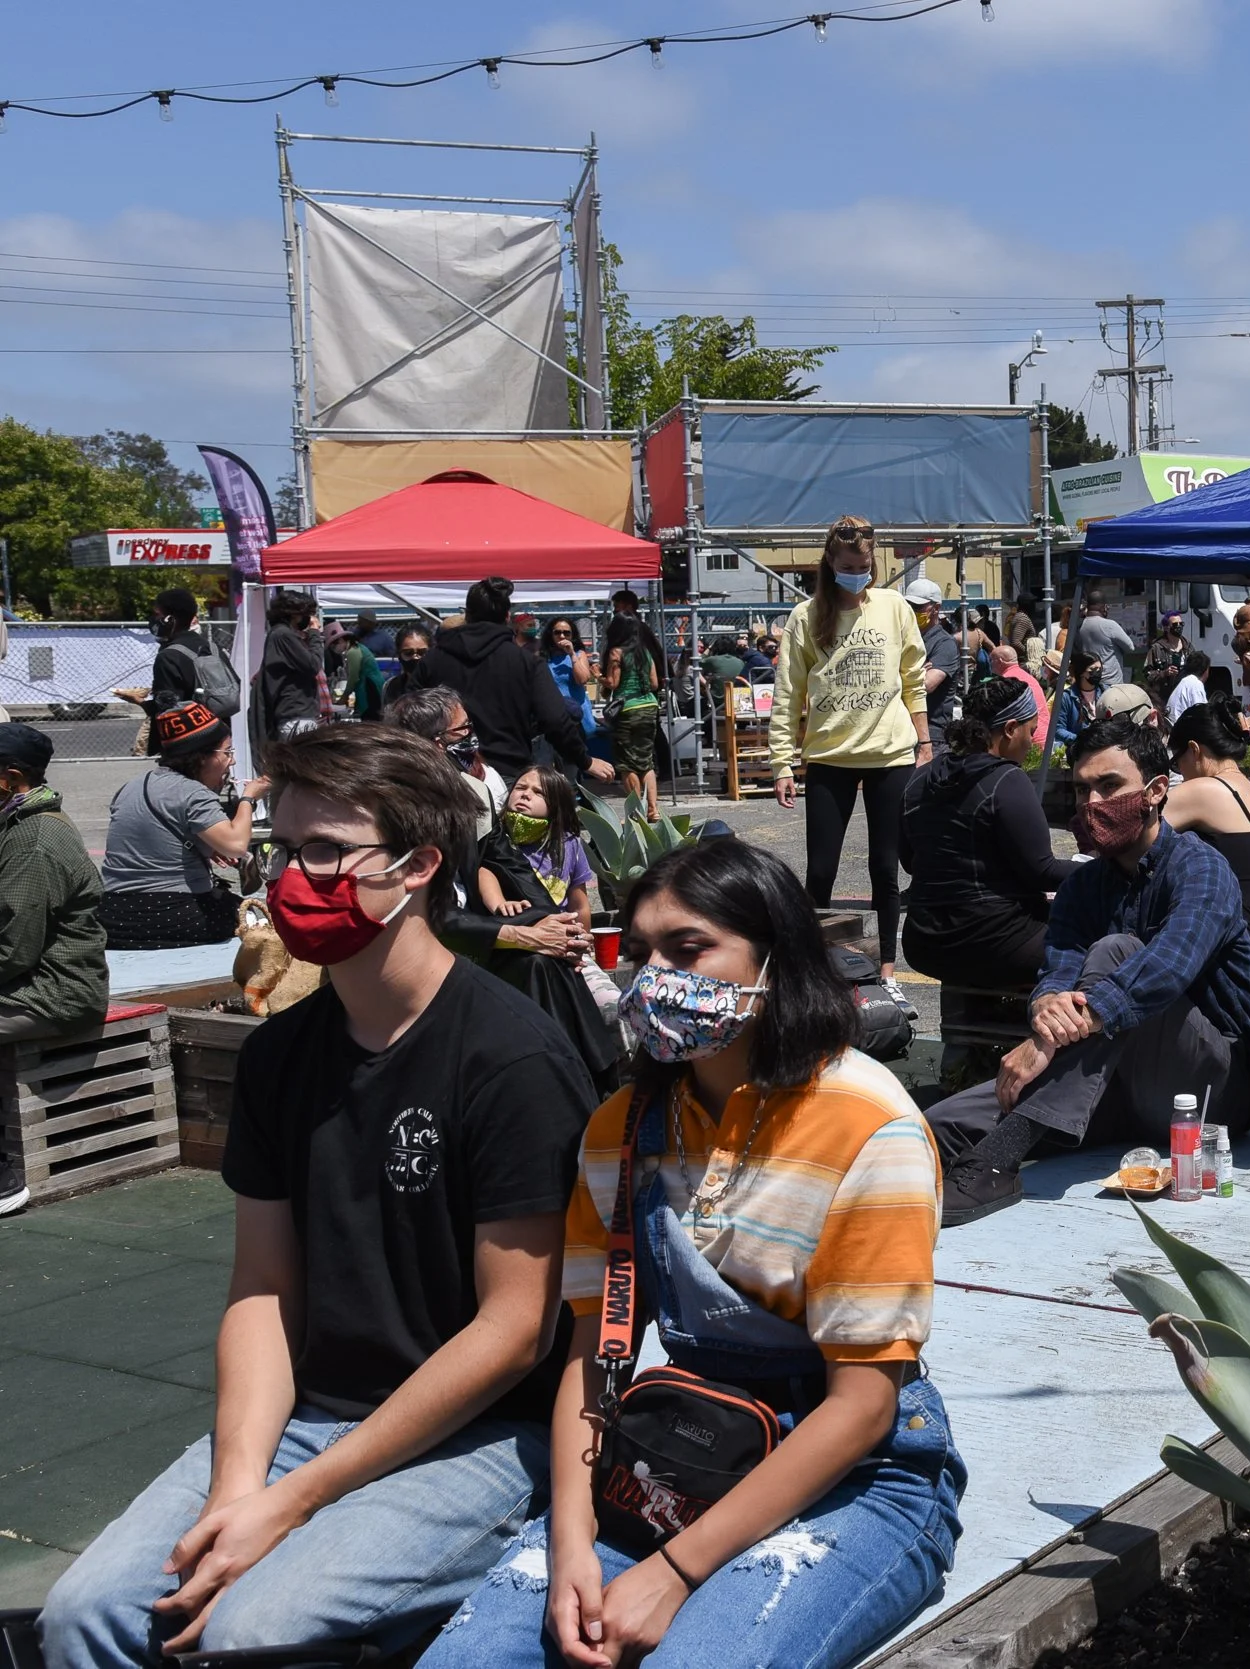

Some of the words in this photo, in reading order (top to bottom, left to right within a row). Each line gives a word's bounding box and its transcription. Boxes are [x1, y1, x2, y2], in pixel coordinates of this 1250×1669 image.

[1101, 471, 1121, 485] CUISINE
[131, 544, 212, 562] EXPRESS
[606, 1248, 633, 1326] NARUTO
[676, 1418, 715, 1441] NARUTO
